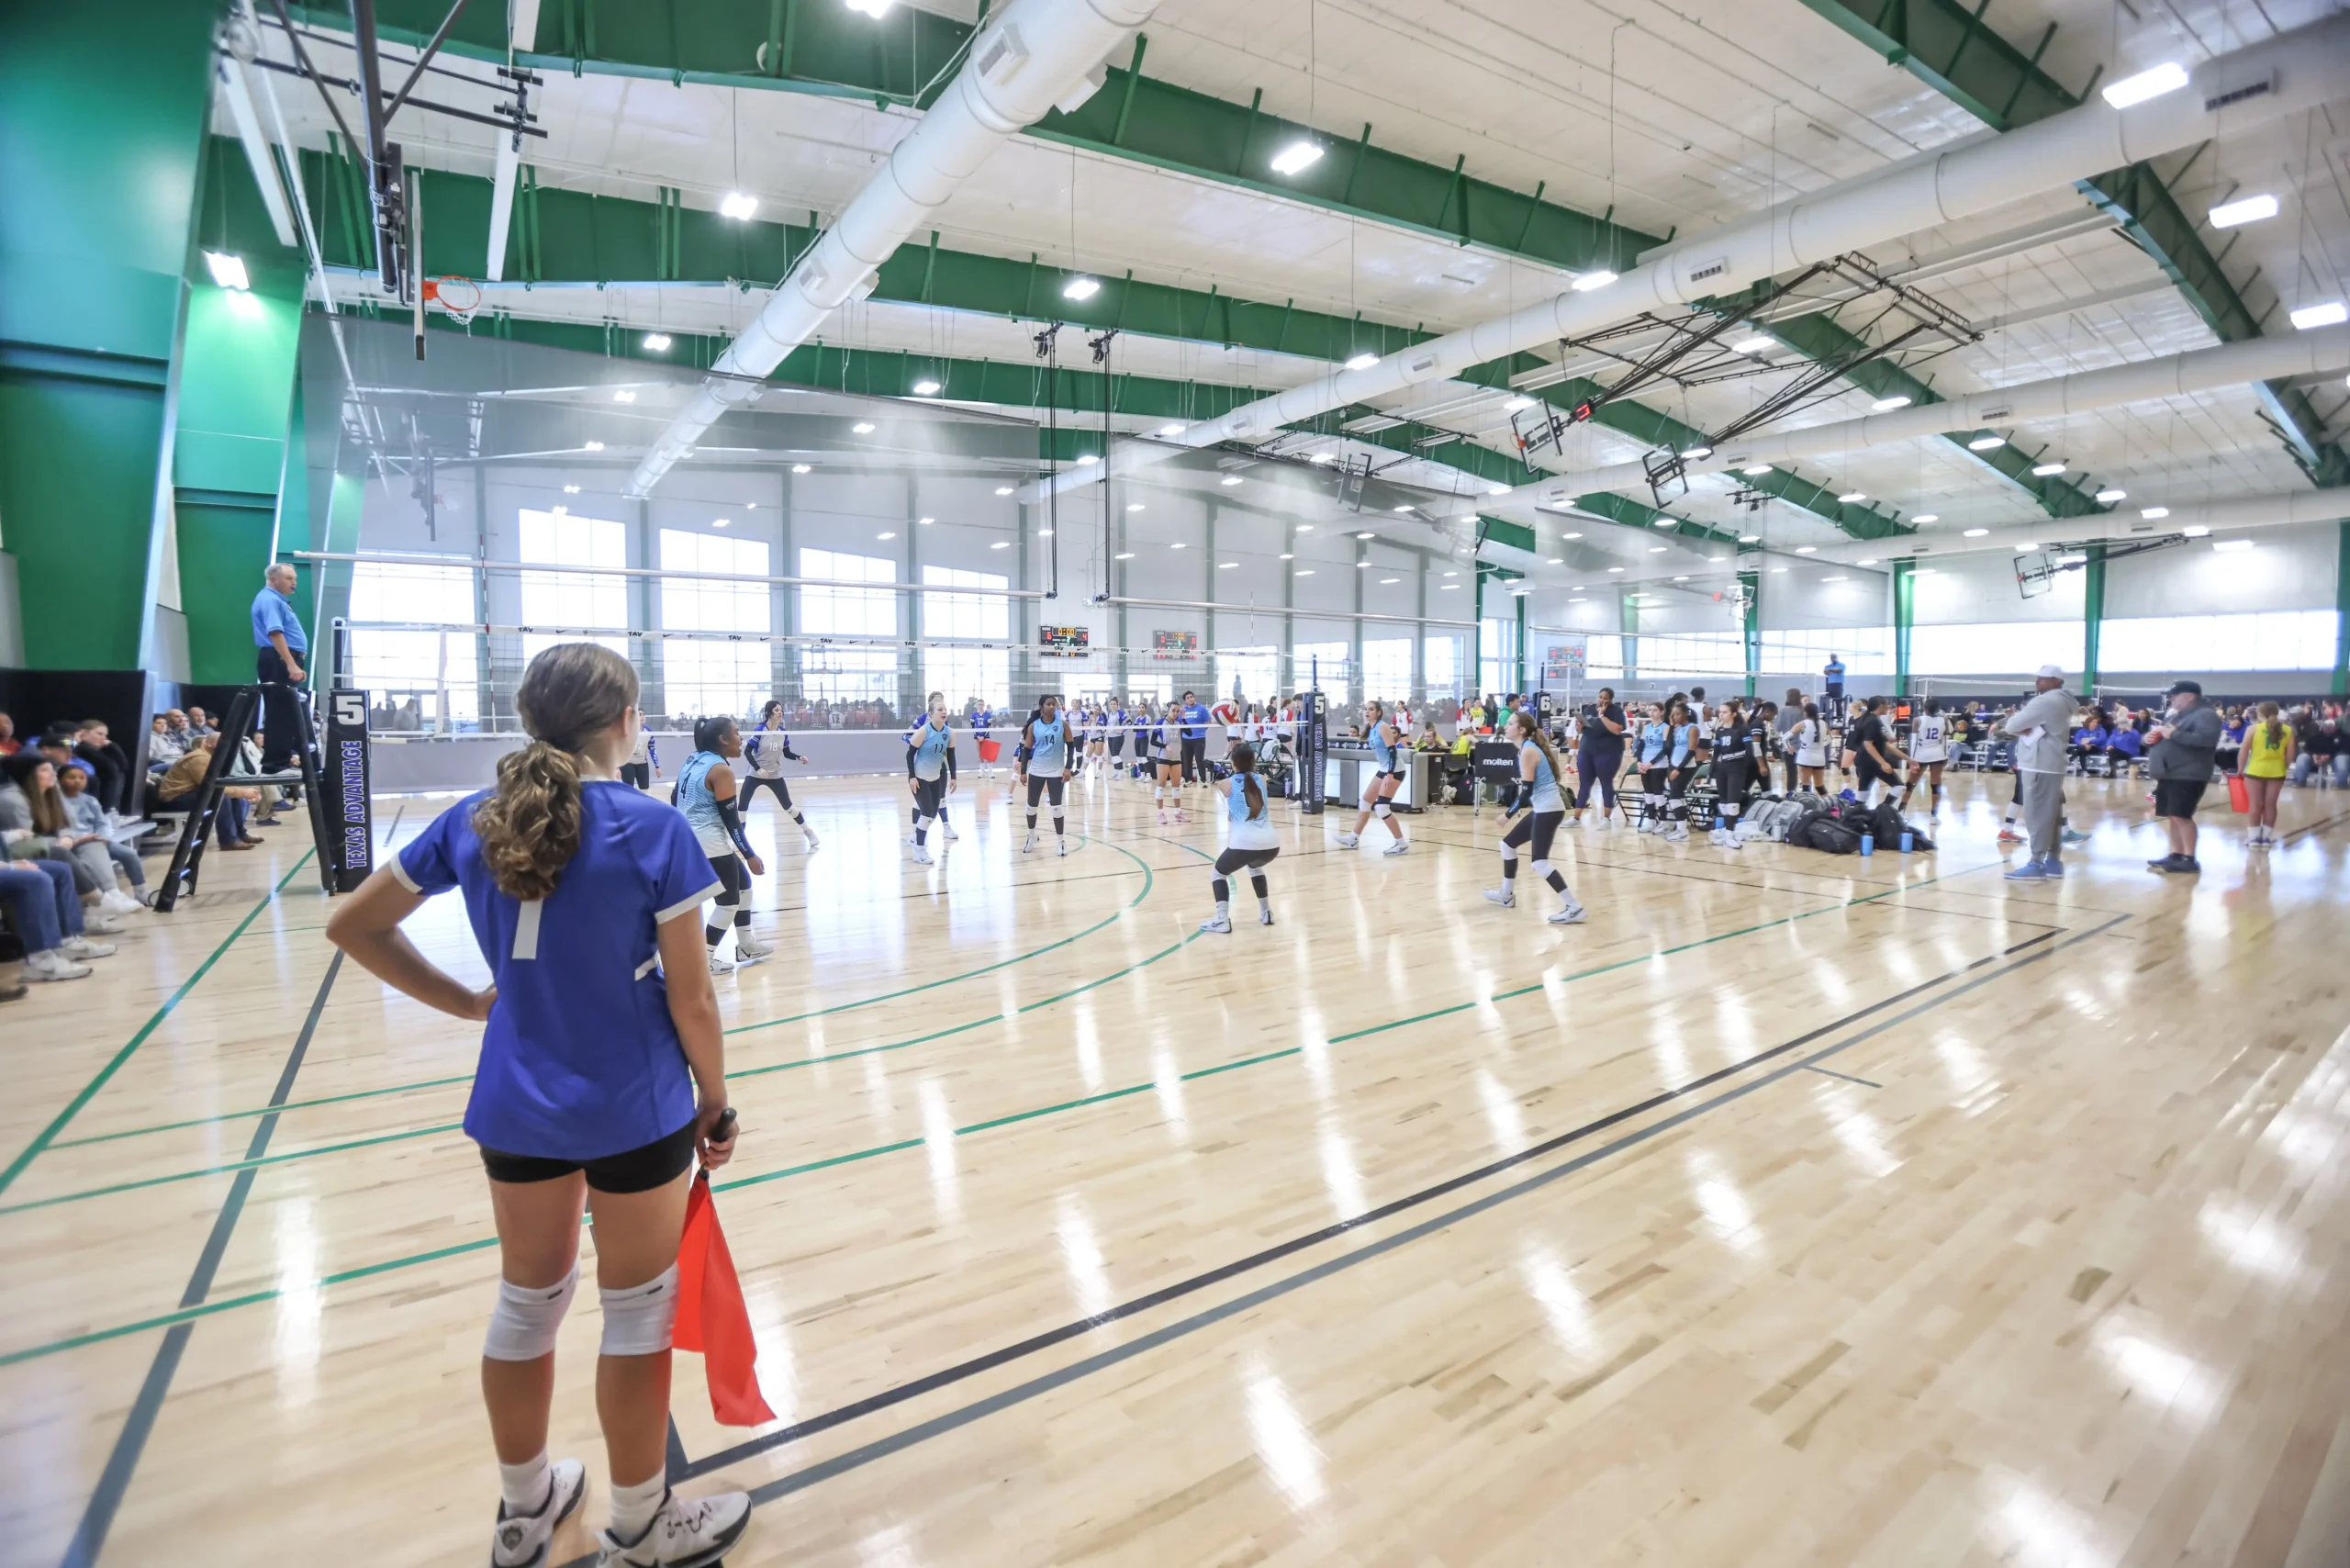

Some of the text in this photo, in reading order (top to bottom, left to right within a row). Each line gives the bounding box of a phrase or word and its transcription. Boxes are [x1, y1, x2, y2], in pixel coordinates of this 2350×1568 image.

[336, 695, 364, 725] 5
[1315, 696, 1324, 714] 5
[1540, 696, 1550, 711] 6
[1045, 734, 1055, 745] 14
[1169, 730, 1178, 738] 22
[1646, 735, 1654, 745] 16
[1721, 735, 1731, 745] 18
[1926, 727, 1939, 740] 12
[769, 742, 778, 752] 18
[934, 743, 944, 753] 11
[1314, 722, 1323, 801] TEXAS ADVANTAGE
[681, 772, 691, 799] 4
[341, 740, 367, 869] TEXAS ADVANTAGE
